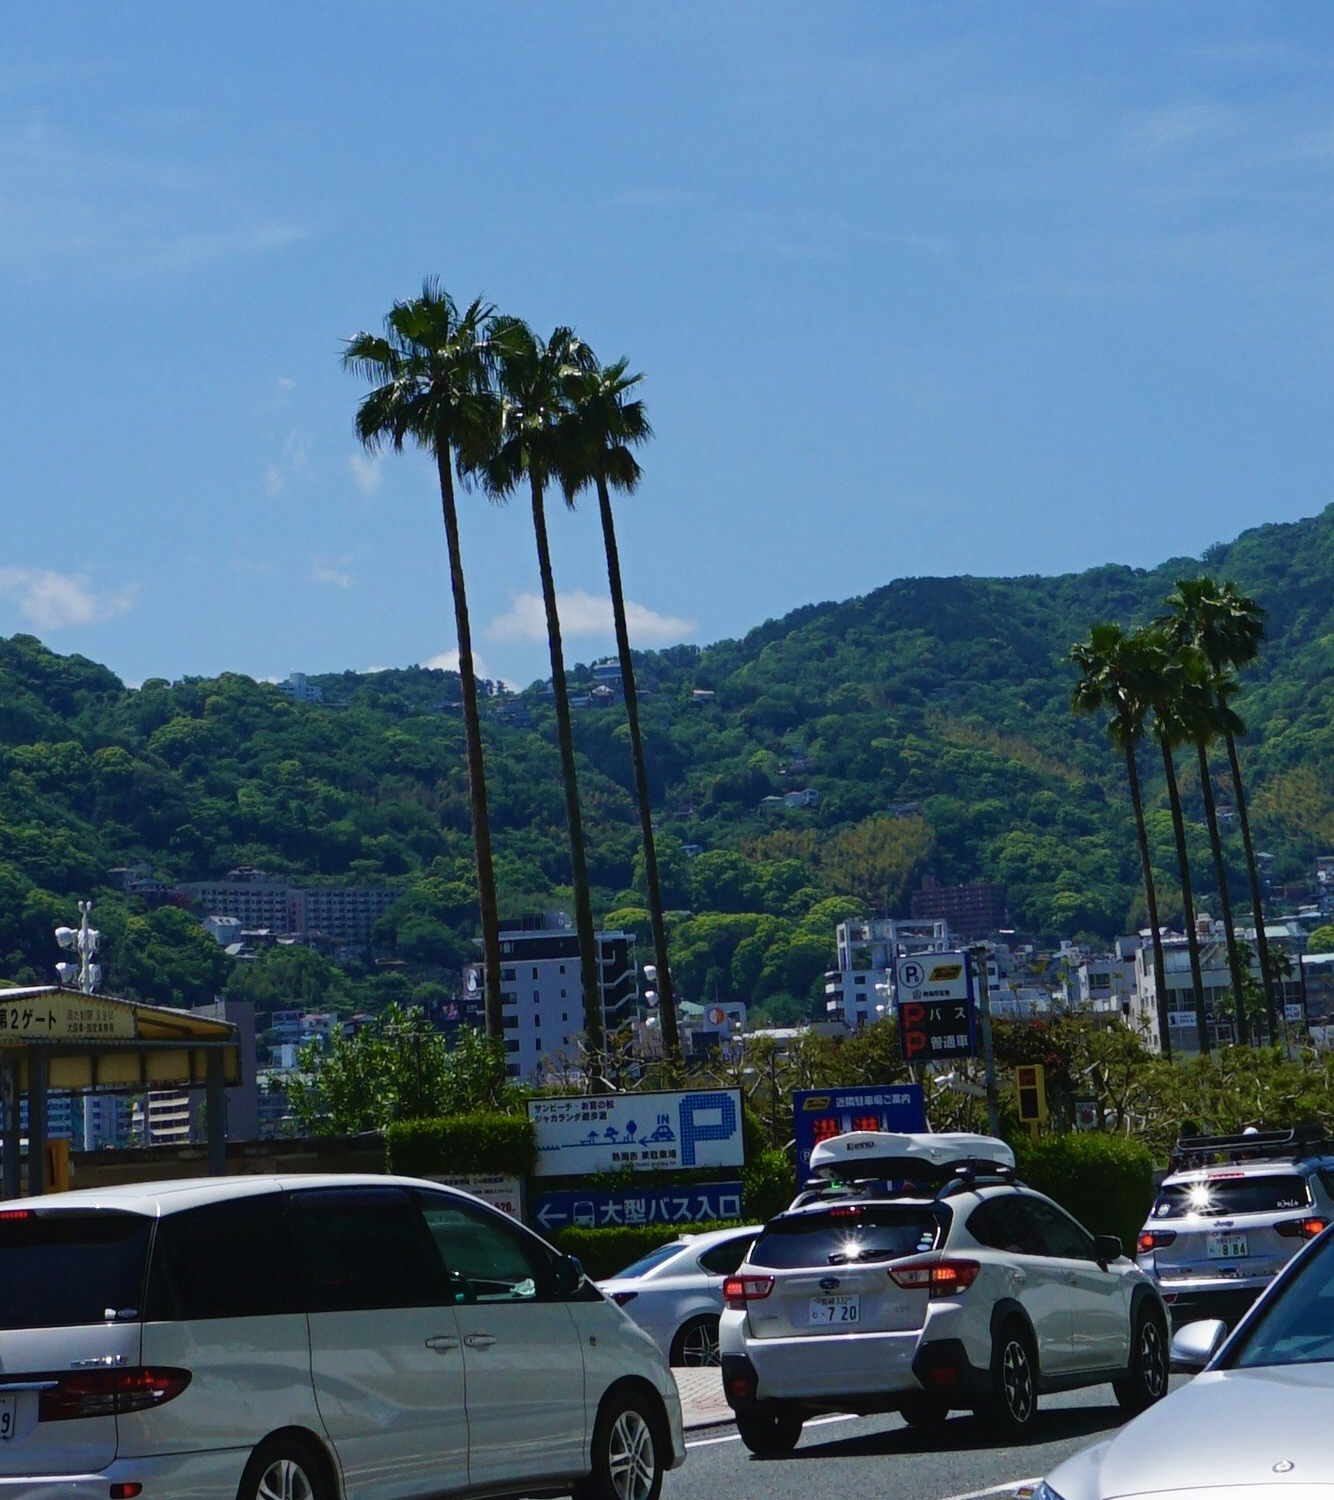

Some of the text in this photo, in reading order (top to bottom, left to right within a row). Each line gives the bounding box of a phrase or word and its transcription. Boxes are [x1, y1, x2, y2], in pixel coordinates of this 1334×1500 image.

[930, 1007, 966, 1021] バス
[931, 1035, 968, 1050] 普通車
[835, 1093, 911, 1108] 近隣駐車場ご案内
[535, 1111, 608, 1123] ジャカランダ遊歩道
[657, 1114, 670, 1124] IN
[612, 1151, 638, 1162] 熱海市
[600, 1194, 740, 1225] 大型バス入口
[841, 1306, 857, 1320] 20
